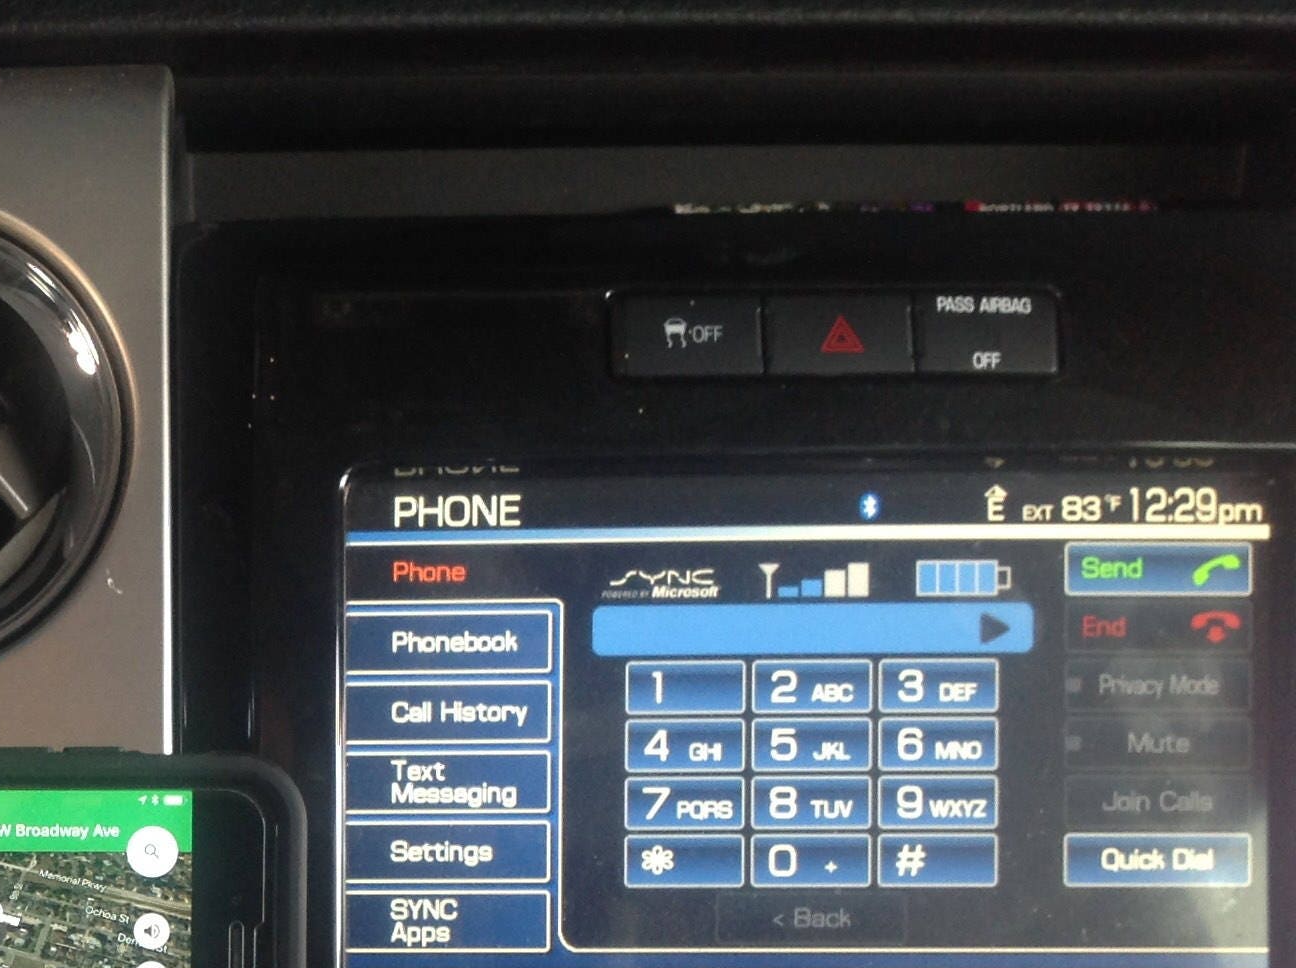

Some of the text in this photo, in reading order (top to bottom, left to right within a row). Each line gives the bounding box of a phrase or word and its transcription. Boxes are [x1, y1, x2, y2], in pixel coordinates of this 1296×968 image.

[937, 297, 1032, 314] PASS AIRBAG
[693, 326, 723, 343] OFF
[973, 352, 1002, 369] OFF
[394, 494, 522, 528] PHONE
[1022, 504, 1054, 521] EXT
[1129, 486, 1263, 524] 12:29pm
[393, 560, 467, 583] Phone
[609, 569, 715, 586] SYNC
[1081, 556, 1144, 580] Send
[651, 585, 720, 599] Microsoft
[1081, 616, 1127, 639] End
[392, 630, 518, 653] Phonebook
[651, 671, 663, 704] 1
[770, 670, 854, 703] 2 ABC
[897, 669, 978, 702] 3 DEF
[1098, 673, 1221, 698] Privacy Mode
[391, 700, 528, 728] Call History
[643, 729, 722, 762] 4 GHI
[770, 728, 851, 761] 5 JKL
[897, 728, 983, 761] 6 MNO
[1127, 731, 1192, 754] Mute
[390, 759, 446, 782] Text
[391, 782, 518, 807] Messaging
[641, 787, 733, 820] 7 PQRS
[769, 786, 854, 819] 8 TUV
[896, 785, 987, 819] 9 WXYZ
[1102, 790, 1214, 813] Join Calls
[15, 824, 89, 840] Broadway
[93, 824, 120, 838] Ave
[390, 840, 493, 867] Settings
[768, 844, 798, 877] 0
[1101, 847, 1214, 872] Quick Dial
[39, 869, 80, 886] Memorial
[85, 905, 117, 921] Ochoa
[390, 900, 459, 921] SYNC
[793, 908, 851, 929] Back
[390, 922, 451, 947] Apps
